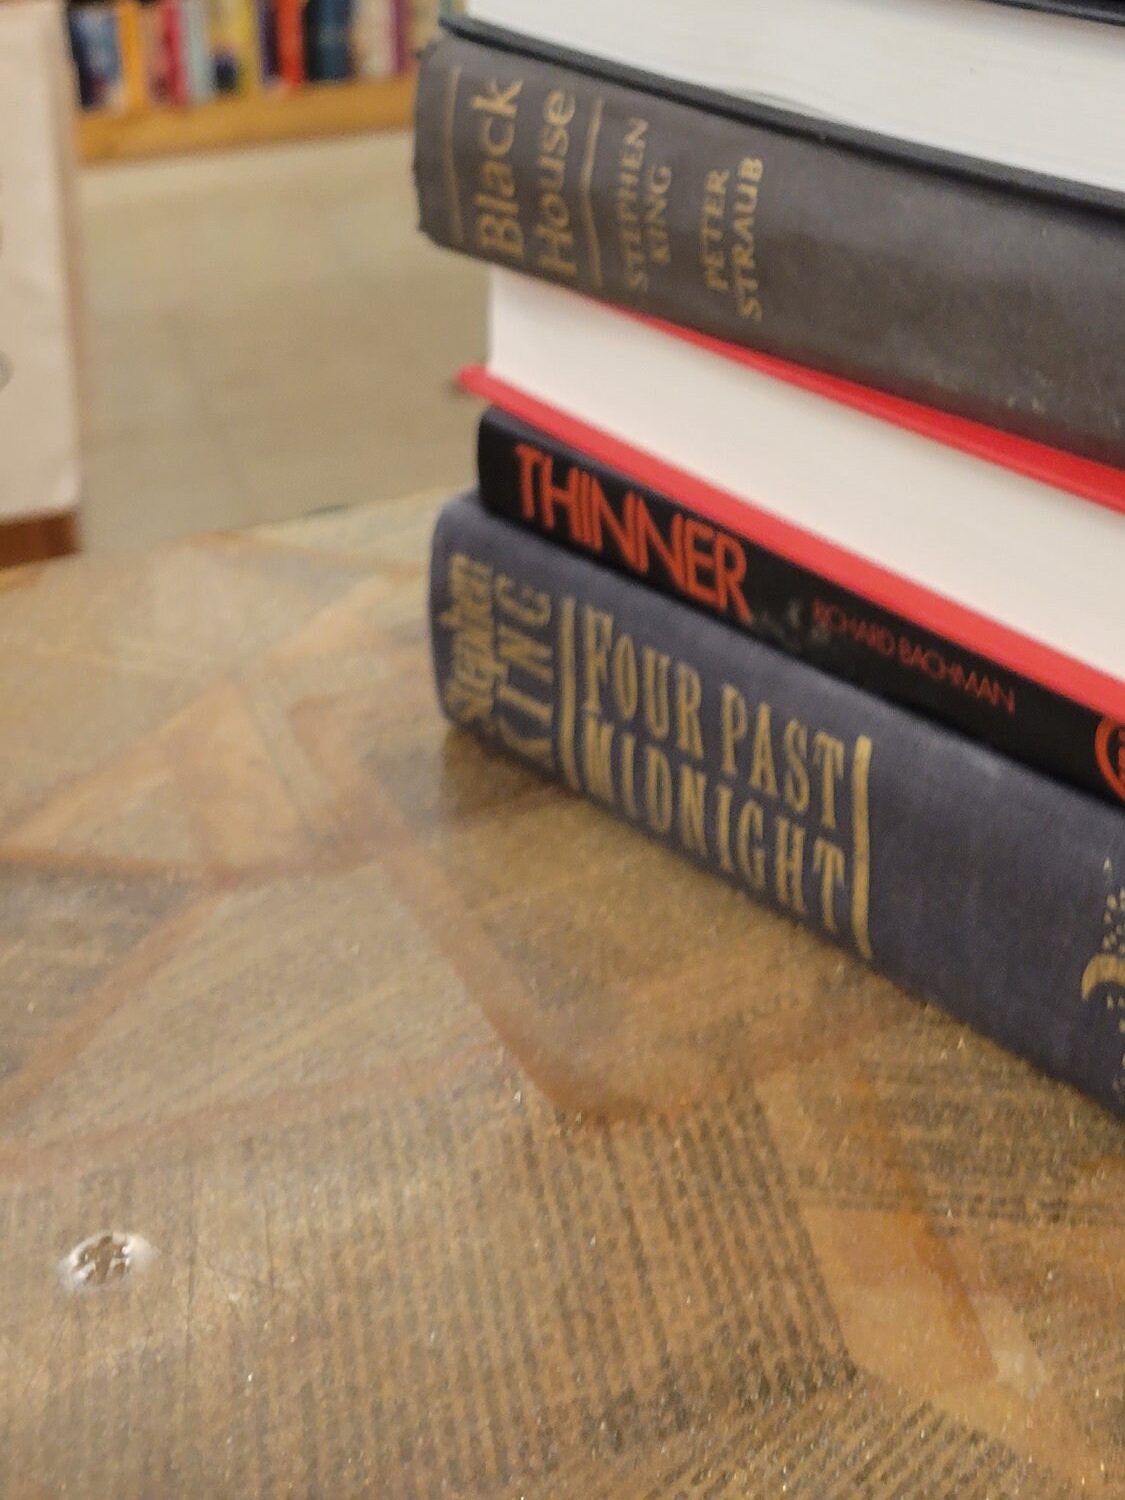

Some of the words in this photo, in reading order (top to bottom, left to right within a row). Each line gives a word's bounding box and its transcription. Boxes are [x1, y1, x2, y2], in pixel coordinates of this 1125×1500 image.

[471, 77, 525, 257] Black
[533, 88, 578, 276] House
[616, 116, 649, 293] STEPHEN
[647, 164, 673, 267] KING
[699, 167, 730, 293] PETER
[731, 155, 764, 325] STRAUB
[514, 443, 752, 626] THINNER
[581, 603, 704, 762] FOUR
[719, 682, 845, 831] PAST
[582, 715, 846, 934] MIDNIGHT
